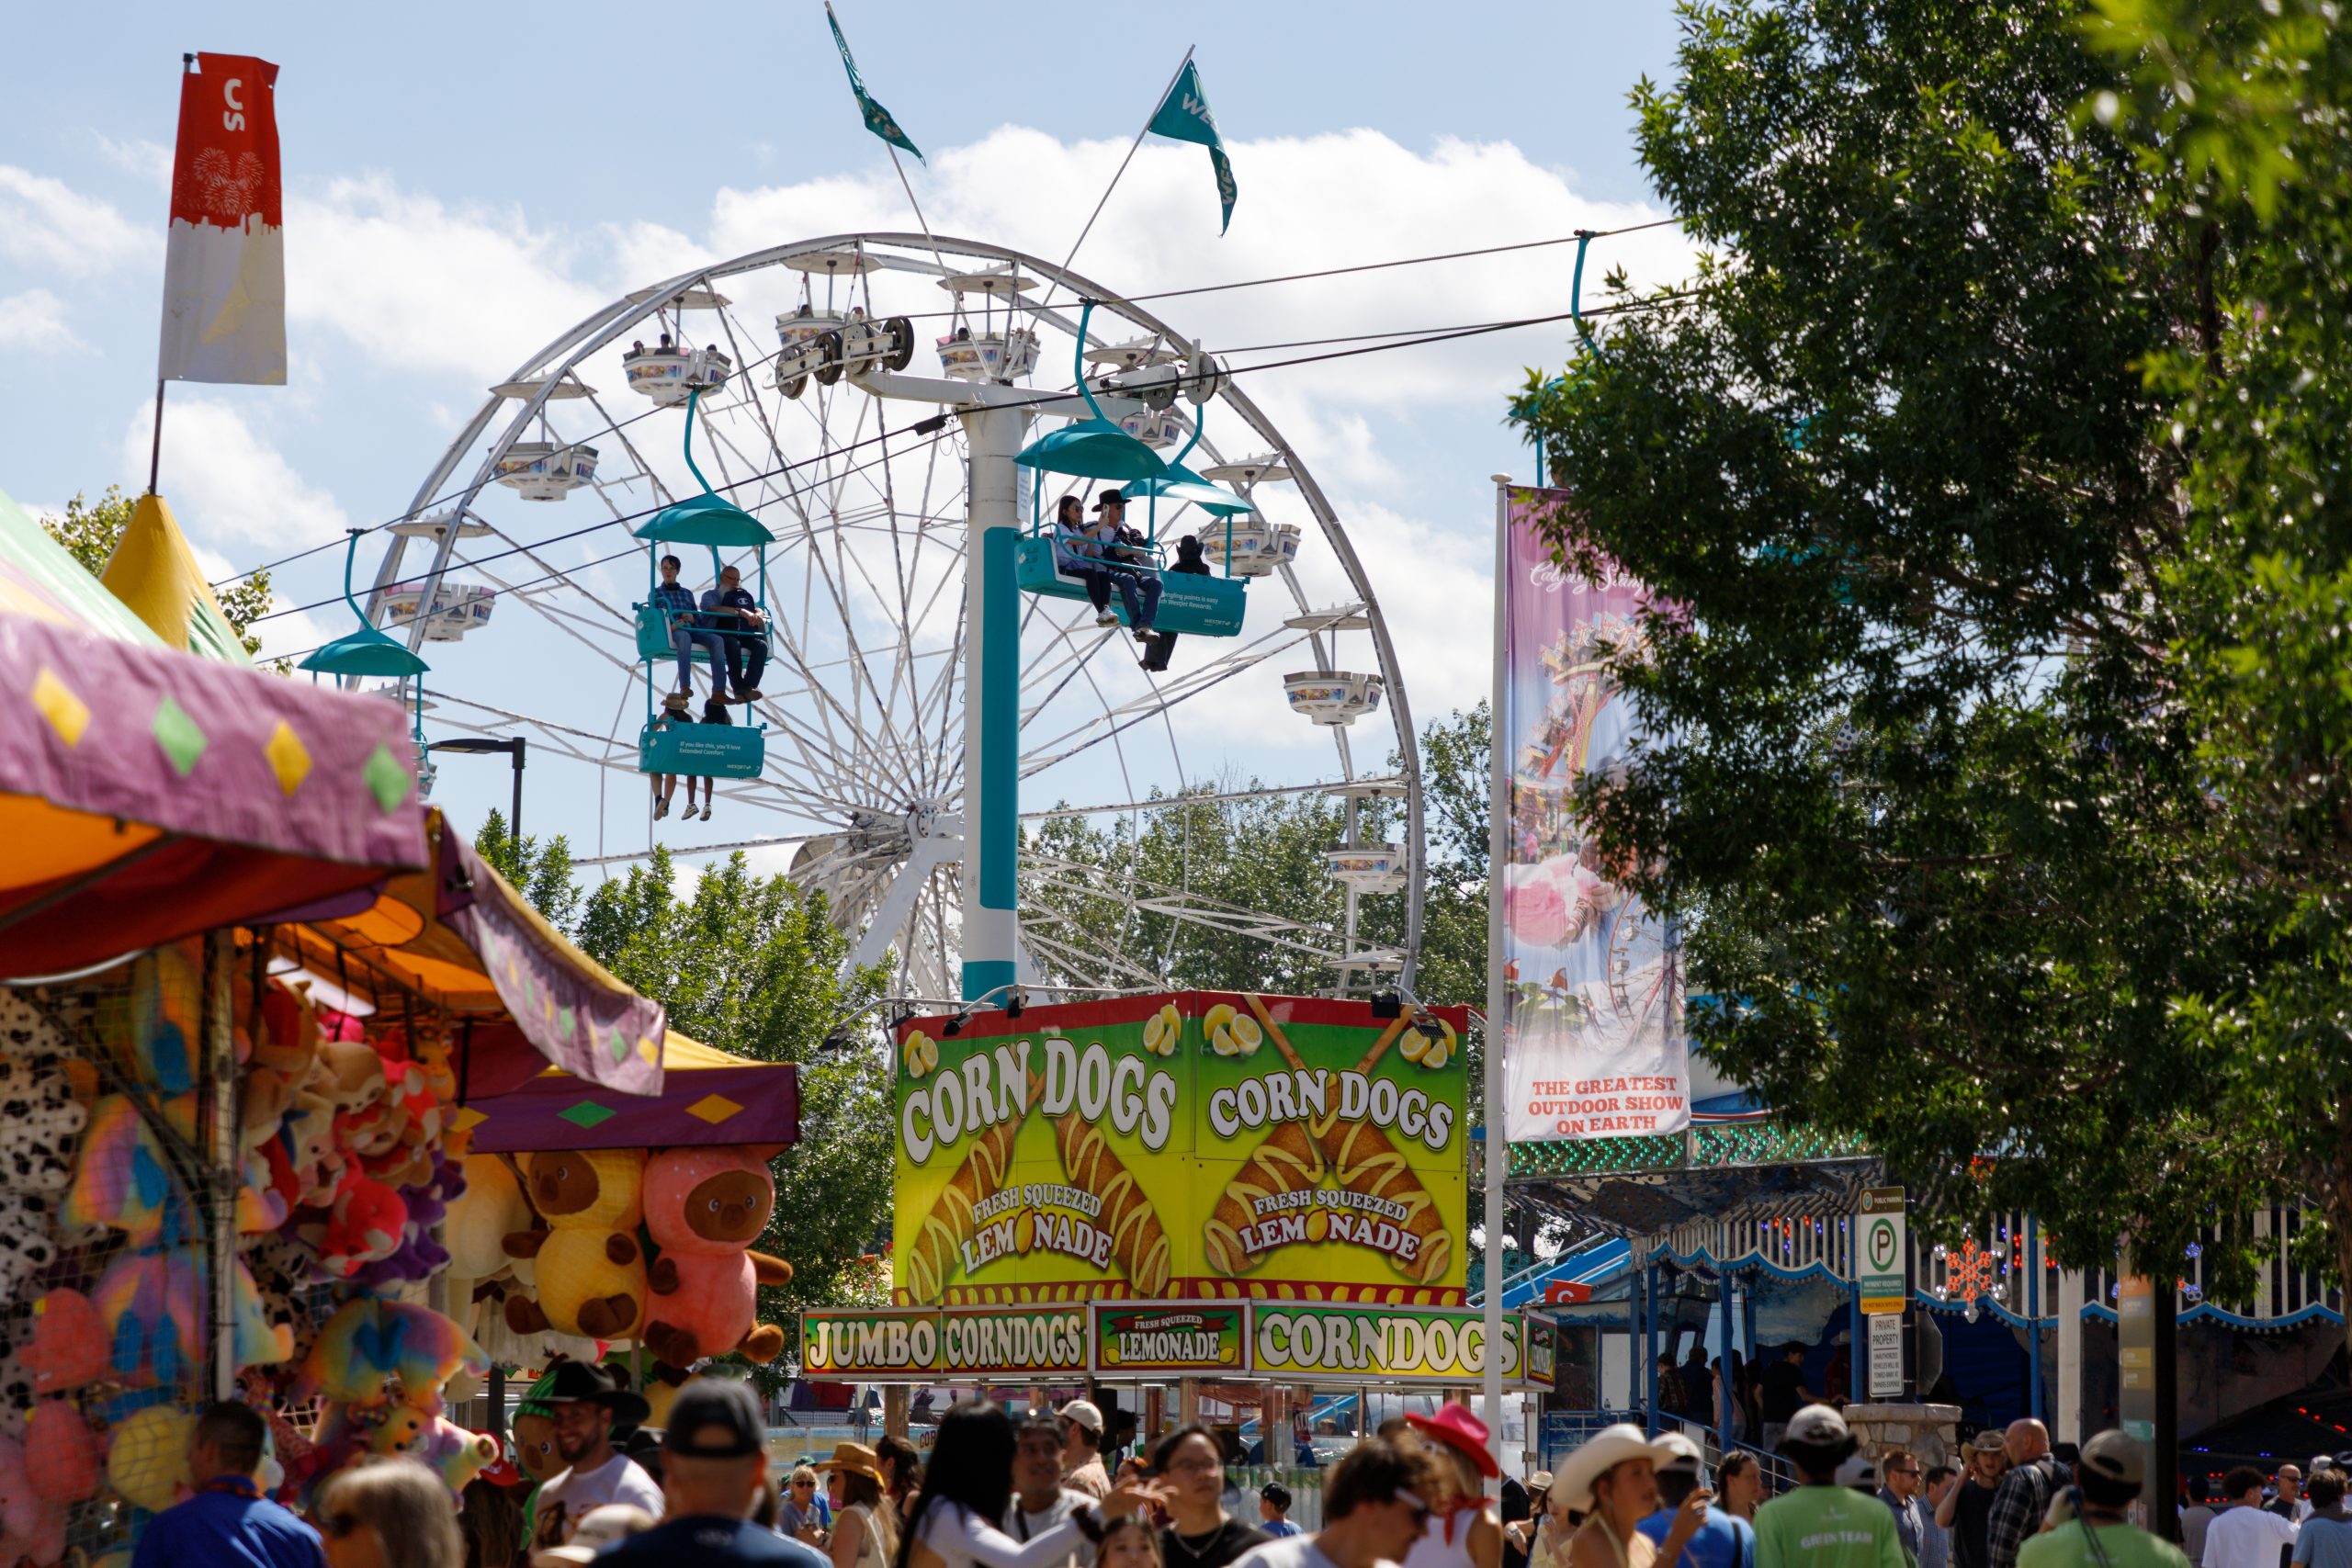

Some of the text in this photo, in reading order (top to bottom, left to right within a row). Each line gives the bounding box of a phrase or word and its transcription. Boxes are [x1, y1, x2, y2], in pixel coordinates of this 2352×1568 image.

[1532, 1076, 1677, 1096] THE GREATEST
[901, 1037, 1177, 1166] CORN DOGS
[1208, 1067, 1455, 1152] CORN DOGS
[1528, 1095, 1683, 1117] OUTDOOR SHOW
[1556, 1116, 1657, 1134] ON EARTH
[973, 1183, 1102, 1224] FRESH SQUEEZED
[1253, 1189, 1408, 1222] FRESH SQUEEZED
[1135, 1314, 1203, 1330] FRESH SQUEEZED
[1875, 1319, 1896, 1331] PRIVATE
[808, 1318, 937, 1368] JUMBO
[945, 1314, 1081, 1367] CORNDOGS
[1119, 1331, 1220, 1361] LEMONADE
[1872, 1334, 1899, 1346] PROPERTY
[1801, 1530, 1873, 1551] GREEN TEAM
